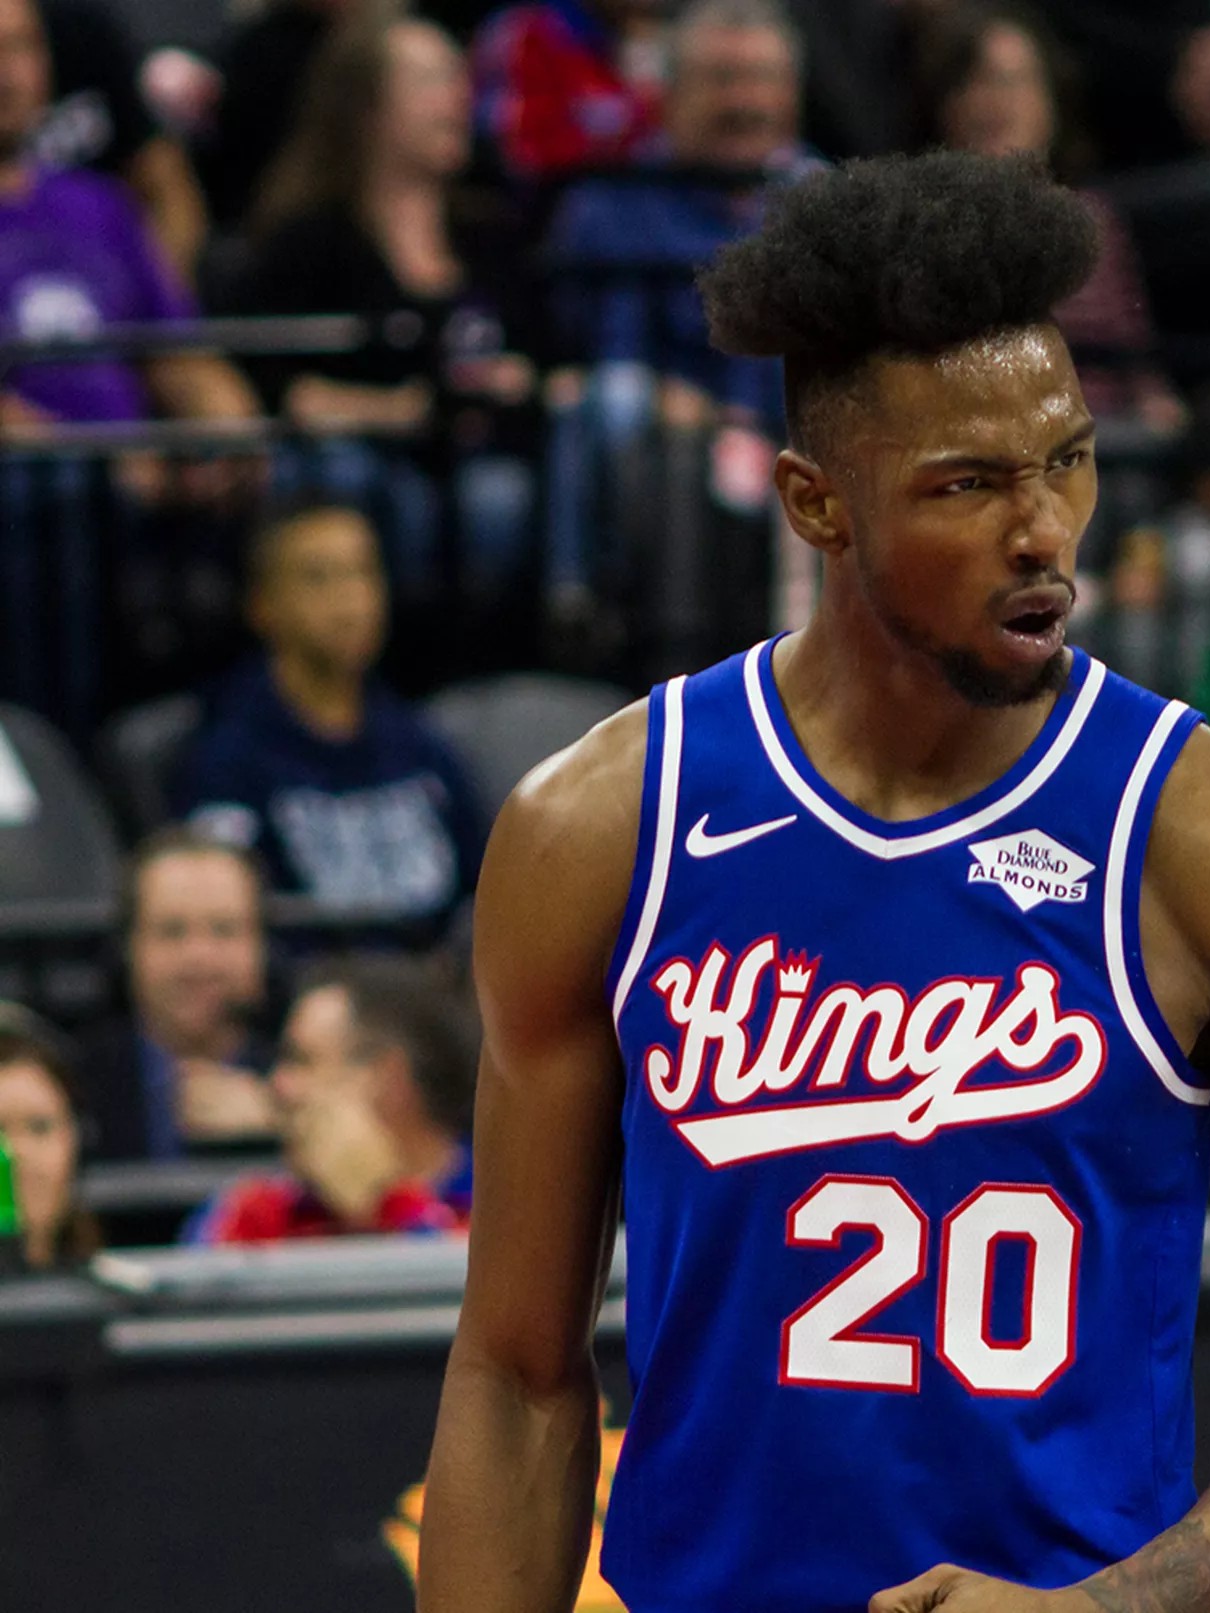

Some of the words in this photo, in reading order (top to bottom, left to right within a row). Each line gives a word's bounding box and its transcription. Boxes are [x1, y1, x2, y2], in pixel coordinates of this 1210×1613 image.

[997, 850, 1068, 874] DIAMOND
[1018, 841, 1053, 860] BLUE
[973, 865, 1083, 899] ALMONDS
[644, 933, 1108, 1170] Kings
[778, 1172, 1083, 1398] 20
